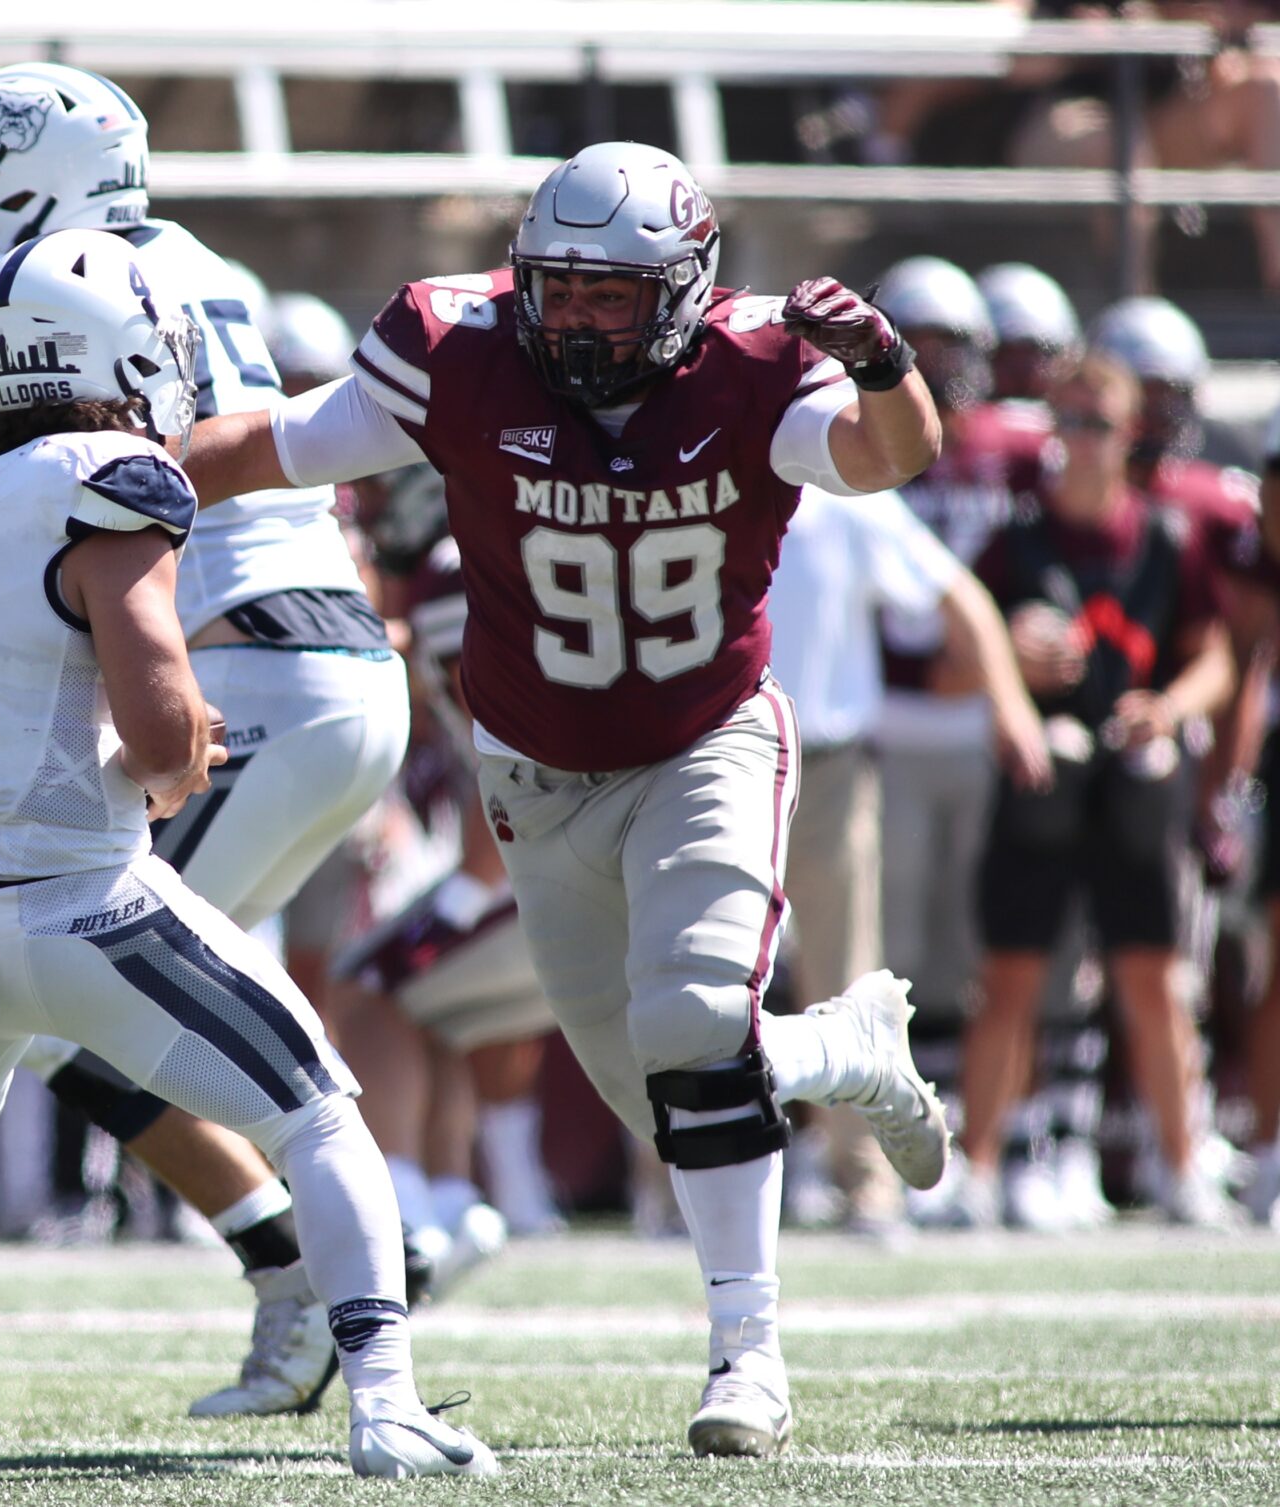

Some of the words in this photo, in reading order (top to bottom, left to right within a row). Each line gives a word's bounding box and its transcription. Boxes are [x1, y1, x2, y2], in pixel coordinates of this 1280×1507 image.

[128, 261, 160, 327] 4
[513, 470, 740, 525] MONTANA
[521, 523, 727, 689] 99
[223, 724, 268, 747] UTLER
[67, 896, 145, 934] BUTLER
